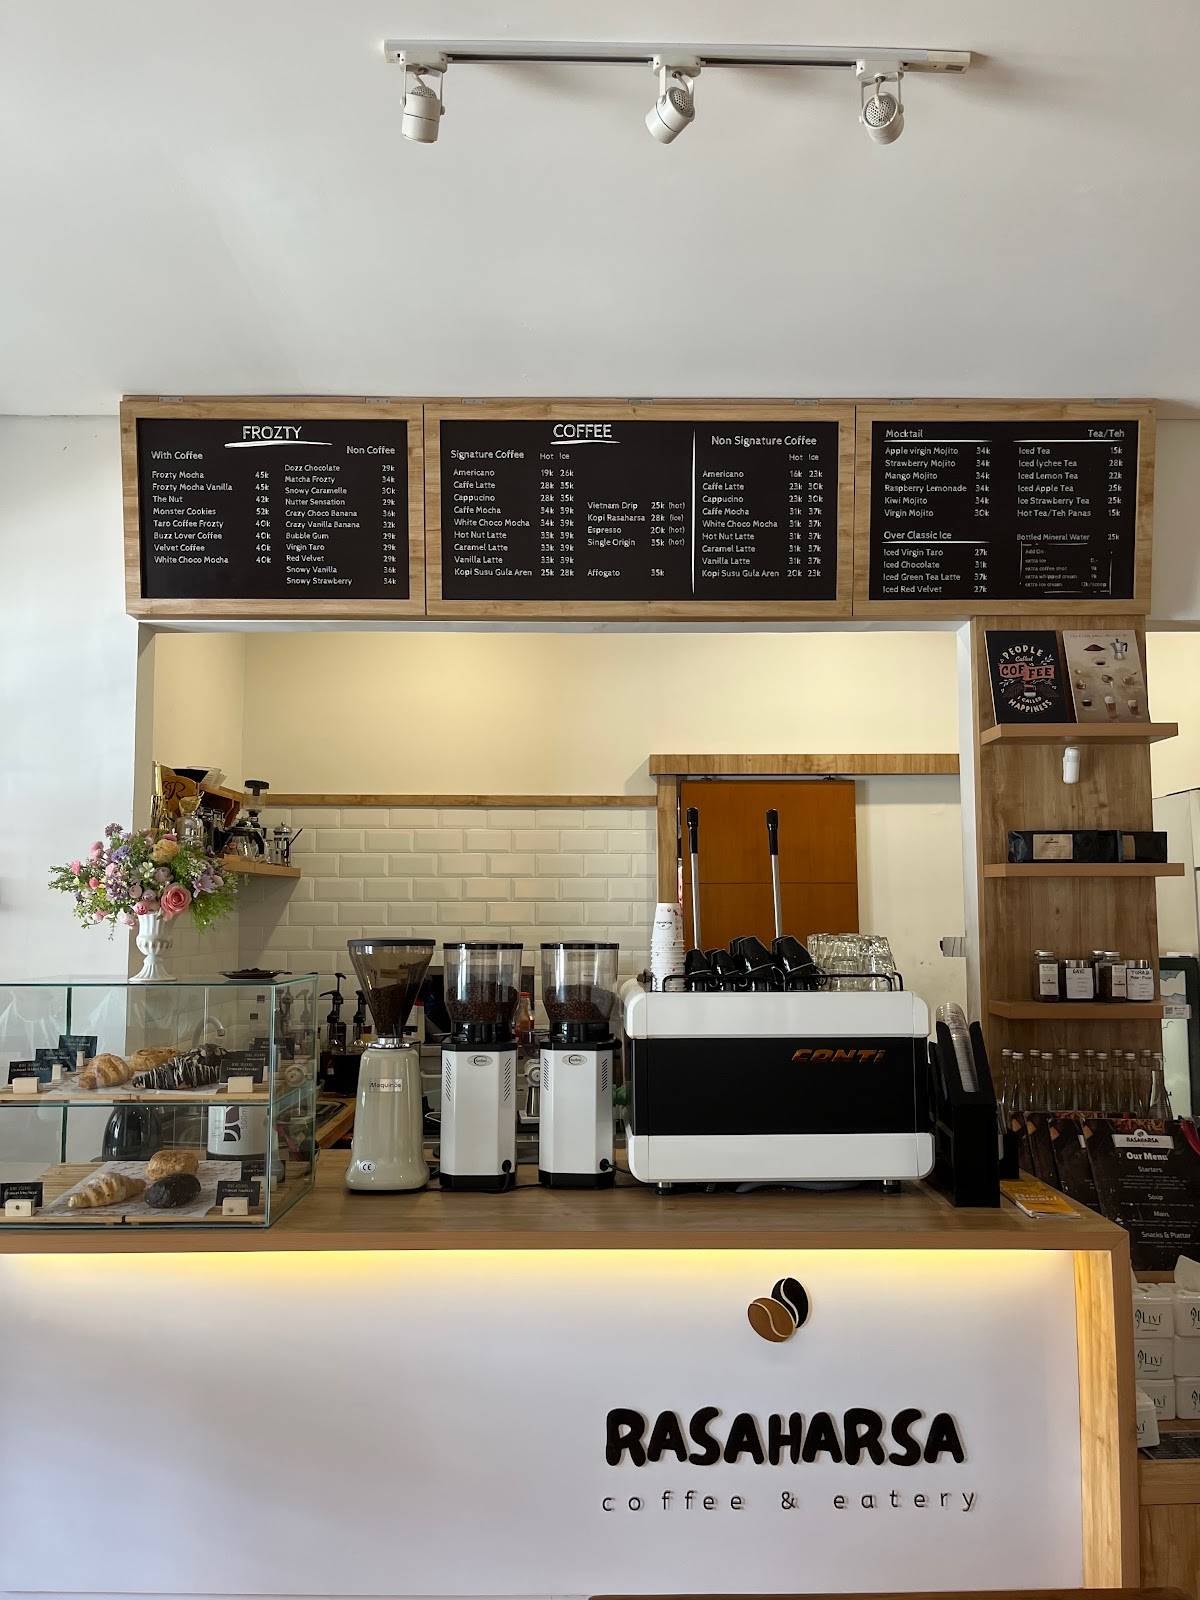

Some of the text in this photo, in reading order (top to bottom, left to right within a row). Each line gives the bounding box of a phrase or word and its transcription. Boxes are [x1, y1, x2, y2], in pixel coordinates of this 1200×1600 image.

[243, 426, 301, 439] FROZTY
[553, 424, 612, 438] COFFEE
[886, 429, 923, 438] Mocktail
[1088, 429, 1124, 438] Tea/Teh
[712, 436, 816, 447] Non Signature Coffee
[347, 446, 395, 454] Non Coffee
[885, 447, 958, 456] Apple virgin Mojito
[151, 451, 203, 459] With Coffee
[451, 450, 524, 460] Signature Coffee
[885, 460, 955, 468] Strawberry Mojito
[1019, 459, 1034, 467] Iced
[1036, 459, 1062, 468] lychee
[152, 471, 177, 480] Frozty
[885, 472, 937, 481] Mango Mojito
[153, 483, 177, 492] Frozty
[285, 487, 309, 495] Snowy
[885, 484, 924, 493] Raspberry
[1035, 485, 1058, 493] Apple
[454, 494, 495, 503] Cappucino
[903, 497, 927, 505] Mojito
[1030, 497, 1073, 506] Strawberry
[622, 502, 638, 511] Drip
[285, 510, 305, 518] Crazy
[884, 509, 933, 518] Virgin Mojito
[588, 514, 605, 523] Kopi
[199, 520, 223, 529] Frozty
[286, 521, 305, 529] Crazy
[588, 526, 621, 535] Espresso
[884, 530, 951, 539] Over Classic Ice
[588, 538, 635, 547] Single Origin
[901, 549, 924, 558] Virgin
[455, 568, 472, 577] Kopi
[495, 568, 513, 576] Gula
[588, 569, 620, 578] Affogato
[1002, 645, 1044, 660] PEOPLE
[1008, 699, 1052, 713] HAPPINESS
[1126, 1152, 1168, 1160] Our Menu
[606, 1407, 964, 1467] RASAHARSA
[602, 1489, 975, 1511] coffee & eatery
